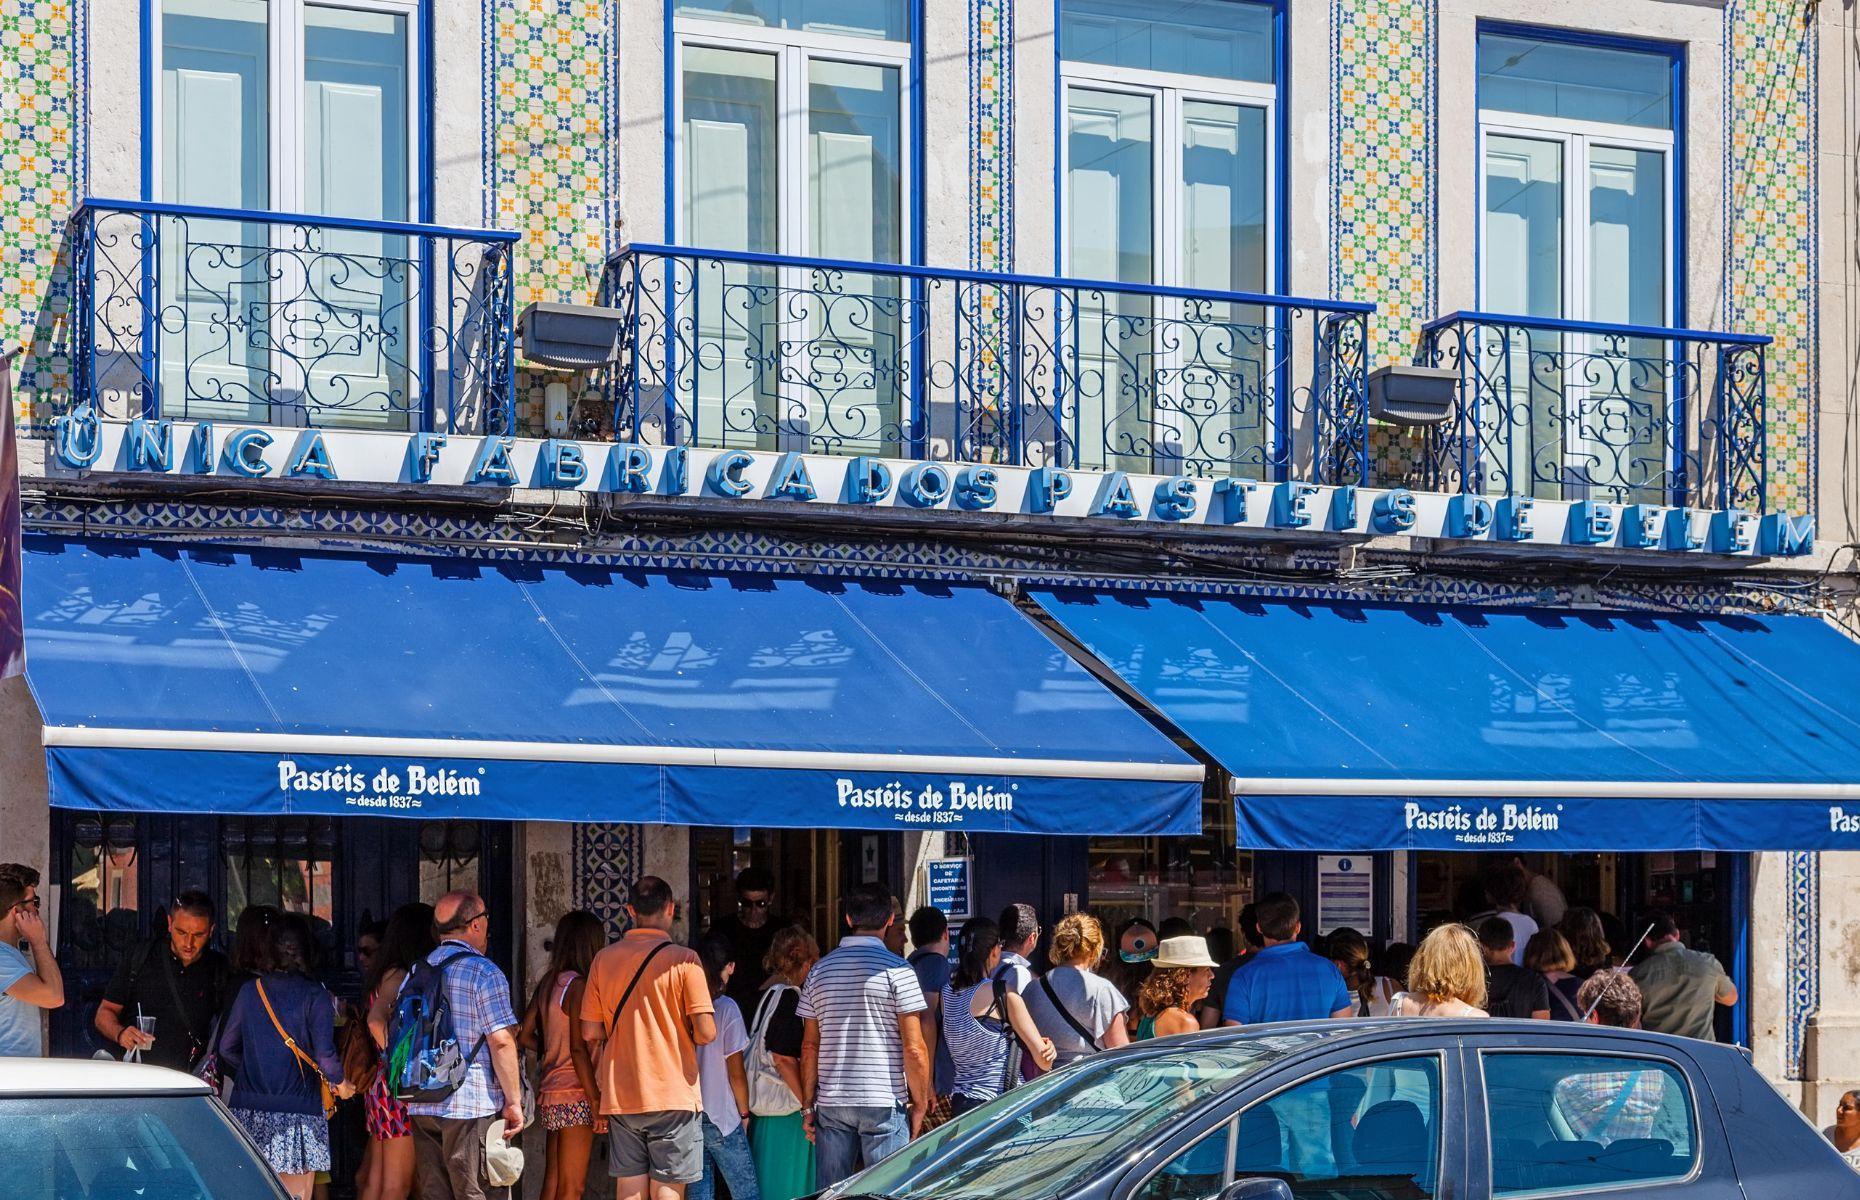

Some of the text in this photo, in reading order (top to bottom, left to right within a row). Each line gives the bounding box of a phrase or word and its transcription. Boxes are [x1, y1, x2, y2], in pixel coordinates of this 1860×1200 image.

[848, 455, 999, 511] DOS
[1449, 493, 1534, 541] DE
[277, 760, 480, 796] Pastéis de Belém
[357, 796, 412, 809] desde 1837
[836, 778, 1012, 811] Pastéis de Belém
[904, 811, 955, 823] desde 1837
[1404, 802, 1559, 832] Pastéis de Belém
[1829, 806, 1860, 832] Pas
[1463, 832, 1507, 843] desde 1837
